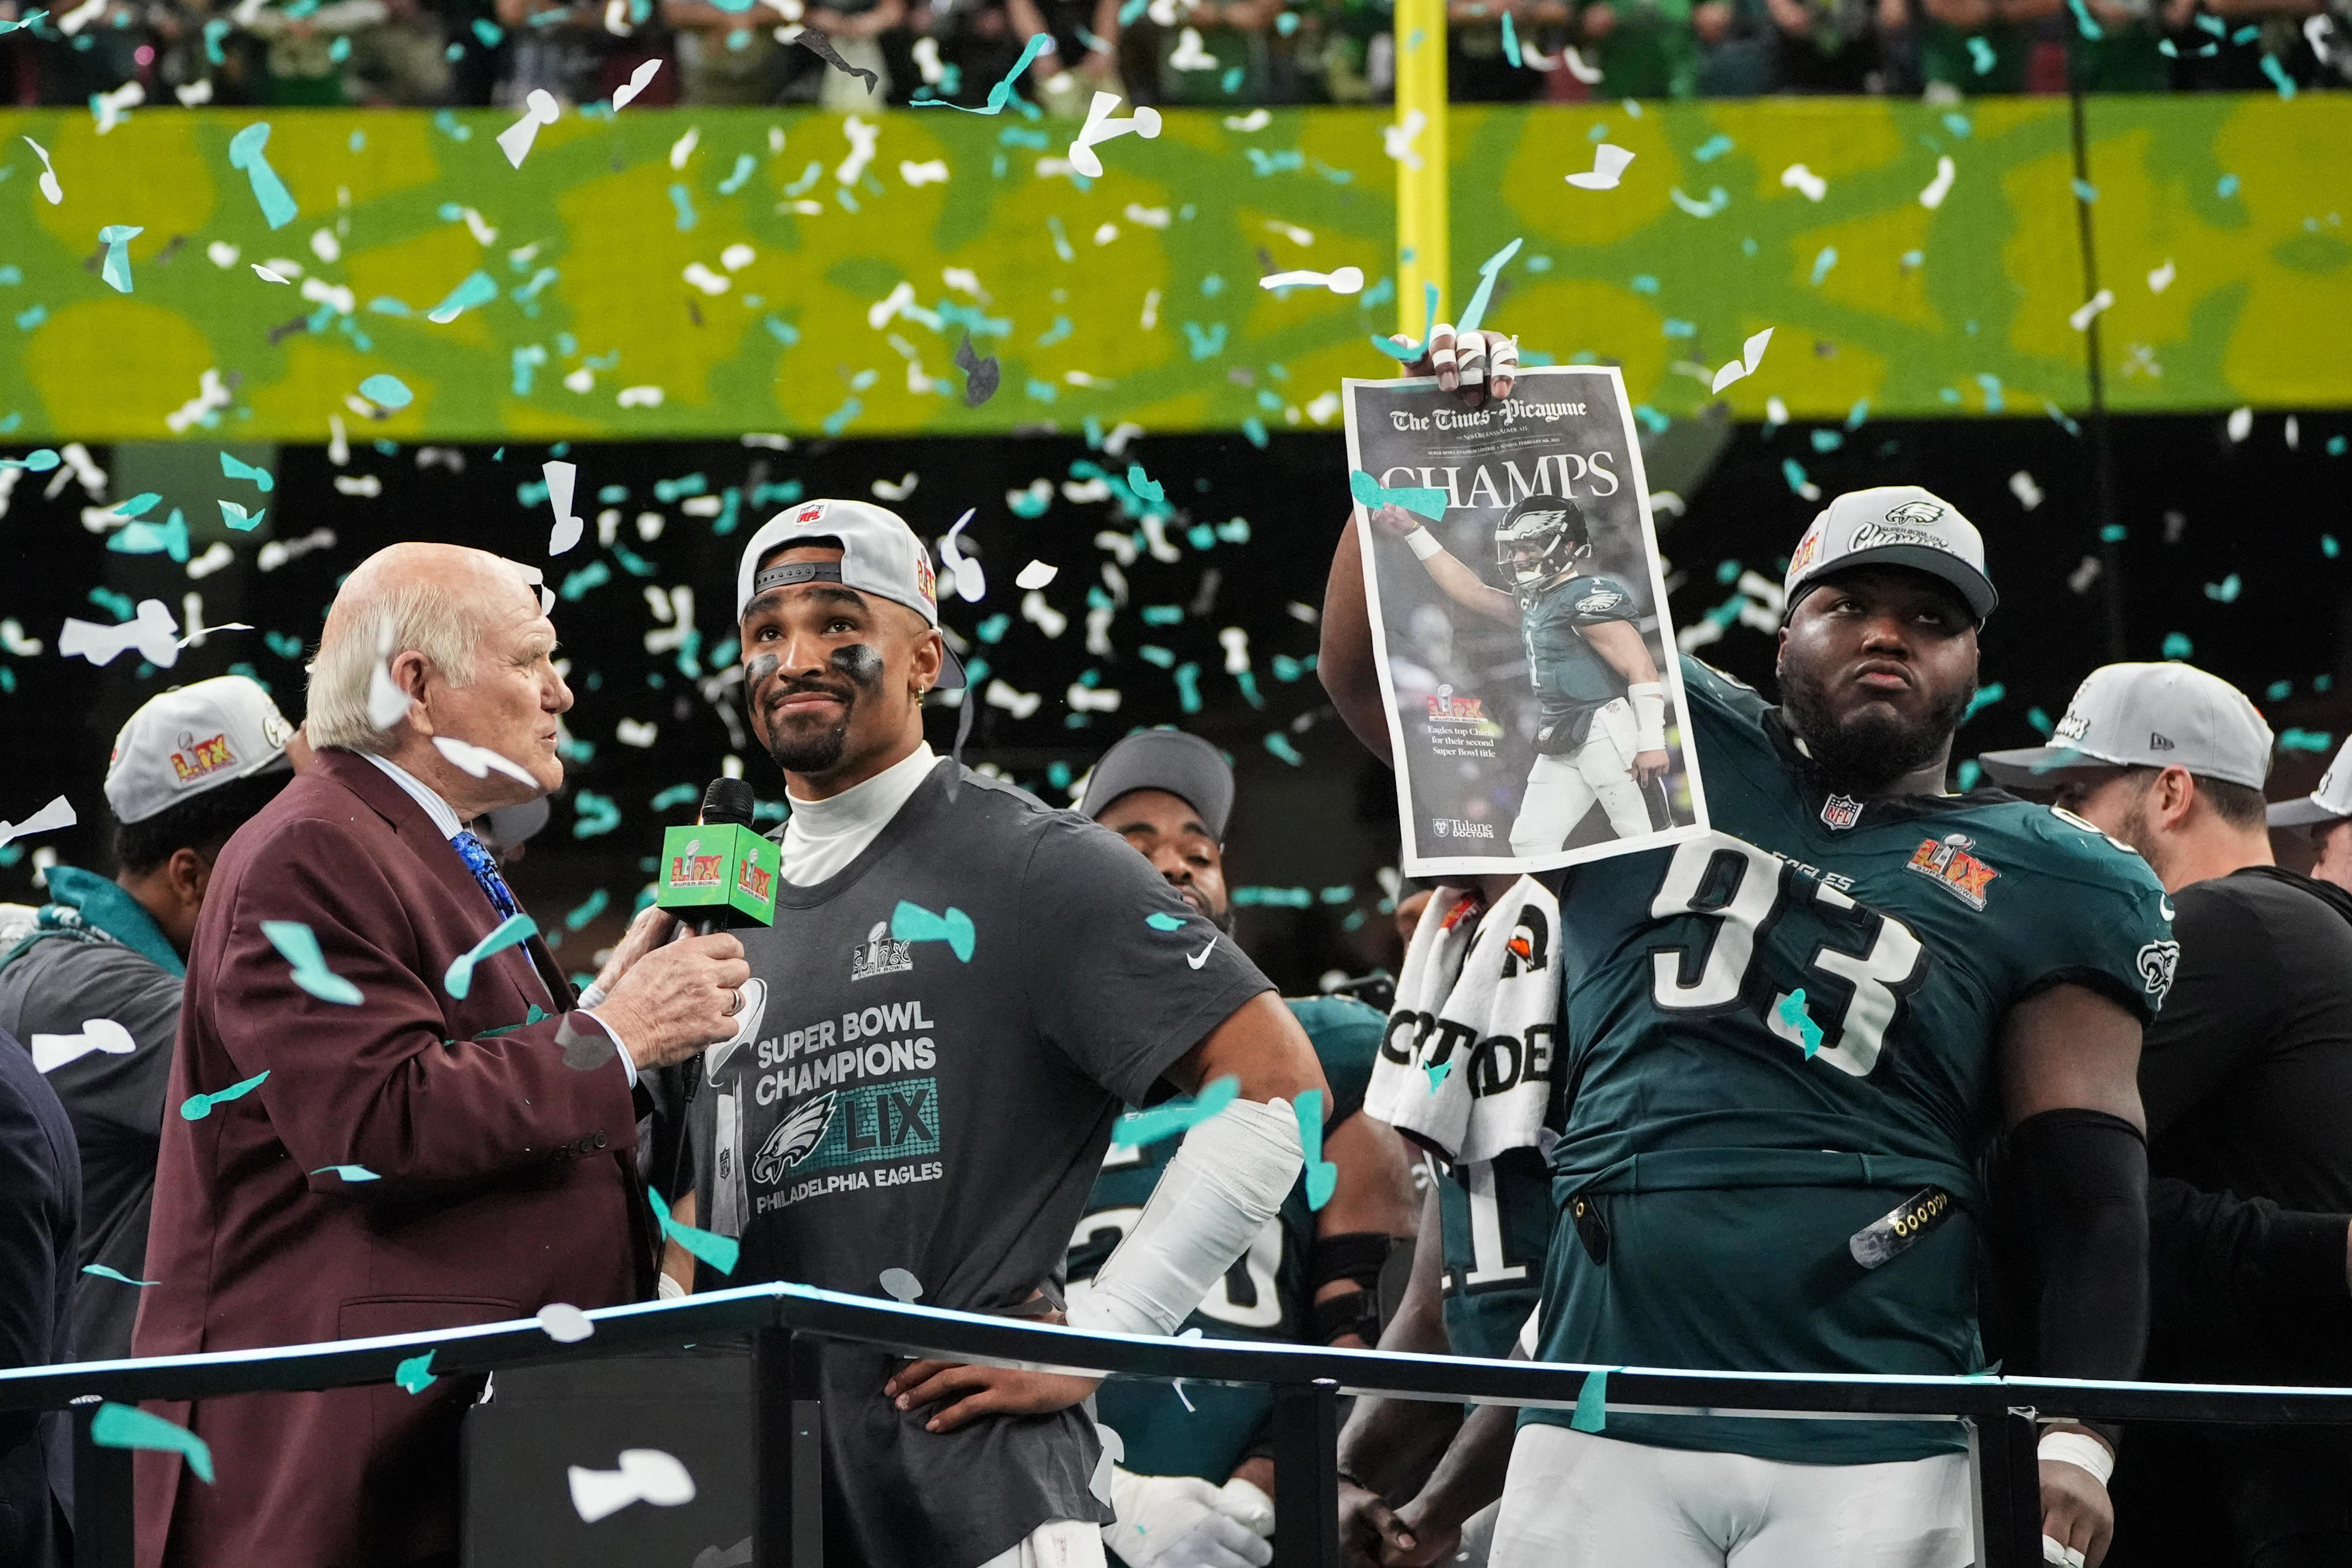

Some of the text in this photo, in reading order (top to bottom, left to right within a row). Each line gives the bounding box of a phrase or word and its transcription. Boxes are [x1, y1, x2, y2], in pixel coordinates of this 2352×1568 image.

[1390, 398, 1588, 431] The Times-Picayune
[1907, 528, 1928, 538] BOWL
[1428, 726, 1495, 737] Eagles top Chiefs
[1432, 735, 1494, 747] for their second
[171, 733, 233, 780] LIX
[1433, 747, 1496, 758] Super Bowl title
[1449, 819, 1493, 832] Tulane
[1827, 806, 1849, 824] NFL
[671, 854, 722, 882] LIX
[740, 886, 766, 904] SUPER BOWL
[1916, 865, 1973, 900] SUPER BOWL
[1650, 827, 1924, 1076] 93
[858, 969, 881, 977] SUPER
[758, 1000, 934, 1069] SUPER BOWL
[755, 1037, 937, 1106] CHAMPIONS
[843, 1088, 937, 1153] LIX
[757, 1161, 943, 1214] PHILADELPHIA EAGLES
